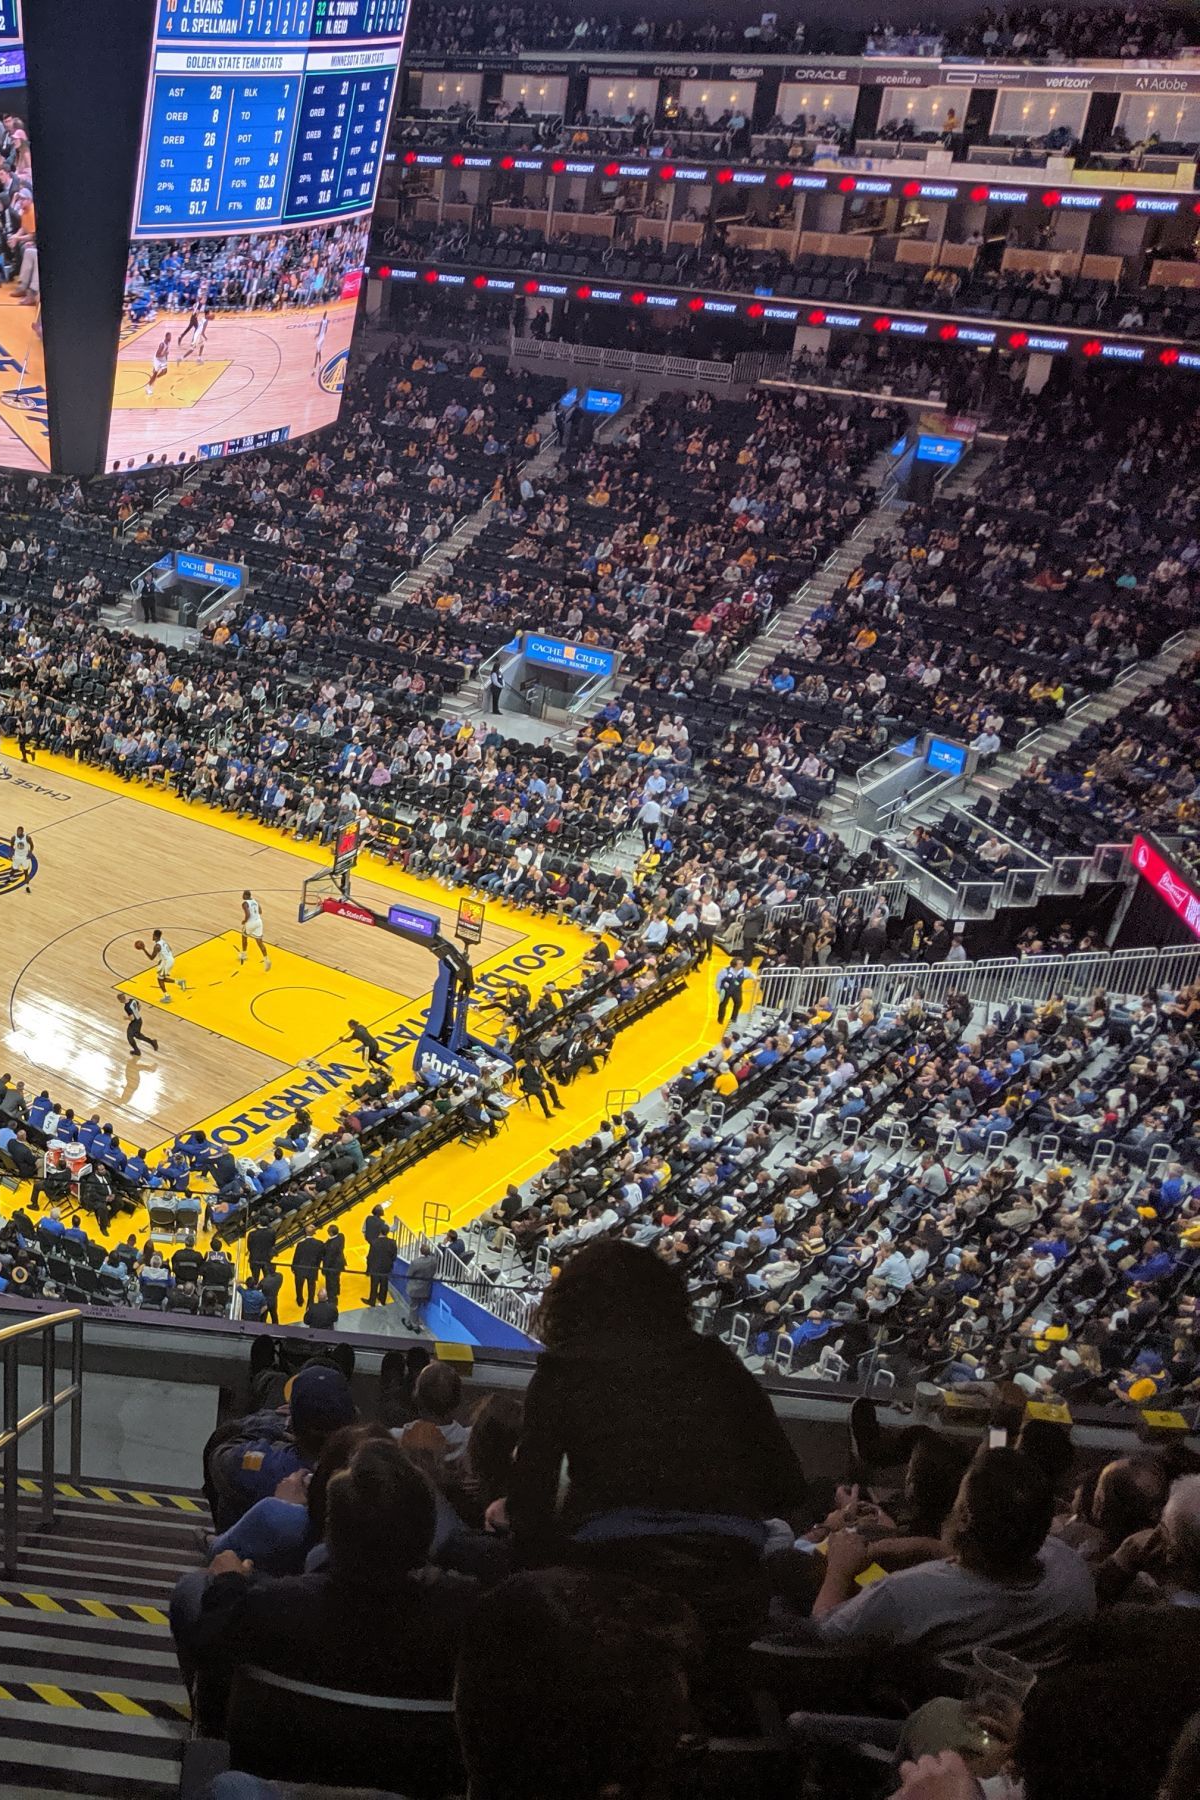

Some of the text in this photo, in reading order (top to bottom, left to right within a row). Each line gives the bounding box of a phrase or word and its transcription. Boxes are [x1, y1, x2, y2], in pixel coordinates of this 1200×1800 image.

[193, 0, 223, 14] EVANS
[317, 2, 326, 15] 32
[336, 2, 358, 15] TOWNS
[166, 20, 172, 31] 4
[191, 20, 237, 34] SPELLMAN
[316, 21, 323, 34] 11
[333, 20, 347, 33] REID
[186, 56, 283, 69] GOLDEN STATE TEAM STATS
[331, 53, 384, 67] MINNESOTA TEAM STATS
[653, 67, 687, 76] CHASE
[795, 69, 848, 81] ORACLE
[875, 75, 922, 85] accenture
[1045, 77, 1089, 88] verizon
[1151, 79, 1188, 90] Adobe
[169, 86, 222, 100] AST 26
[244, 85, 289, 98] BLK 7
[313, 86, 325, 95] AST
[166, 109, 219, 123] OREB 8
[241, 108, 286, 121] TO 14
[309, 108, 325, 117] OREB
[238, 130, 282, 144] POT 17
[306, 126, 341, 139] DREB 25
[163, 132, 216, 147] DREB 26
[234, 153, 279, 166] PITP 34
[303, 147, 338, 161] STL 5
[160, 156, 213, 169] STL 5
[515, 161, 543, 169] KEYSIGHT
[566, 165, 595, 173] KEYSIGHT
[620, 167, 650, 176] KEYSIGHT
[676, 171, 707, 180] KEYSIGHT
[733, 174, 767, 183] KEYSIGHT
[157, 178, 210, 192] 2P% 53.5
[231, 175, 276, 189] FG% 52.8
[793, 178, 828, 188] KEYSIGHT
[856, 182, 892, 192] KEYSIGHT
[921, 187, 958, 197] KEYSIGHT
[989, 192, 1028, 201] KEYSIGHT
[229, 197, 272, 211] FT% 88.9
[1061, 196, 1102, 206] KEYSIGHT
[1136, 200, 1179, 211] KEYSIGHT
[154, 201, 207, 215] 3P% 51.7
[488, 279, 516, 289] KEYSIGHT
[539, 284, 568, 294] KEYSIGHT
[592, 290, 622, 300] KEYSIGHT
[647, 296, 678, 306] KEYSIGHT
[705, 302, 737, 313] KEYSIGHT
[764, 308, 798, 319] KEYSIGHT
[826, 315, 861, 326] KEYSIGHT
[891, 322, 928, 334] KEYSIGHT
[958, 329, 997, 342] KEYSIGHT
[1028, 338, 1069, 350] KEYSIGHT
[1103, 346, 1145, 359] KEYSIGHT
[211, 445, 223, 457] 107
[181, 561, 237, 580] CACHE CREEK
[532, 643, 607, 667] CACHE CREEK
[547, 656, 588, 670] CASINO RESORT
[11, 778, 72, 802] CHASE
